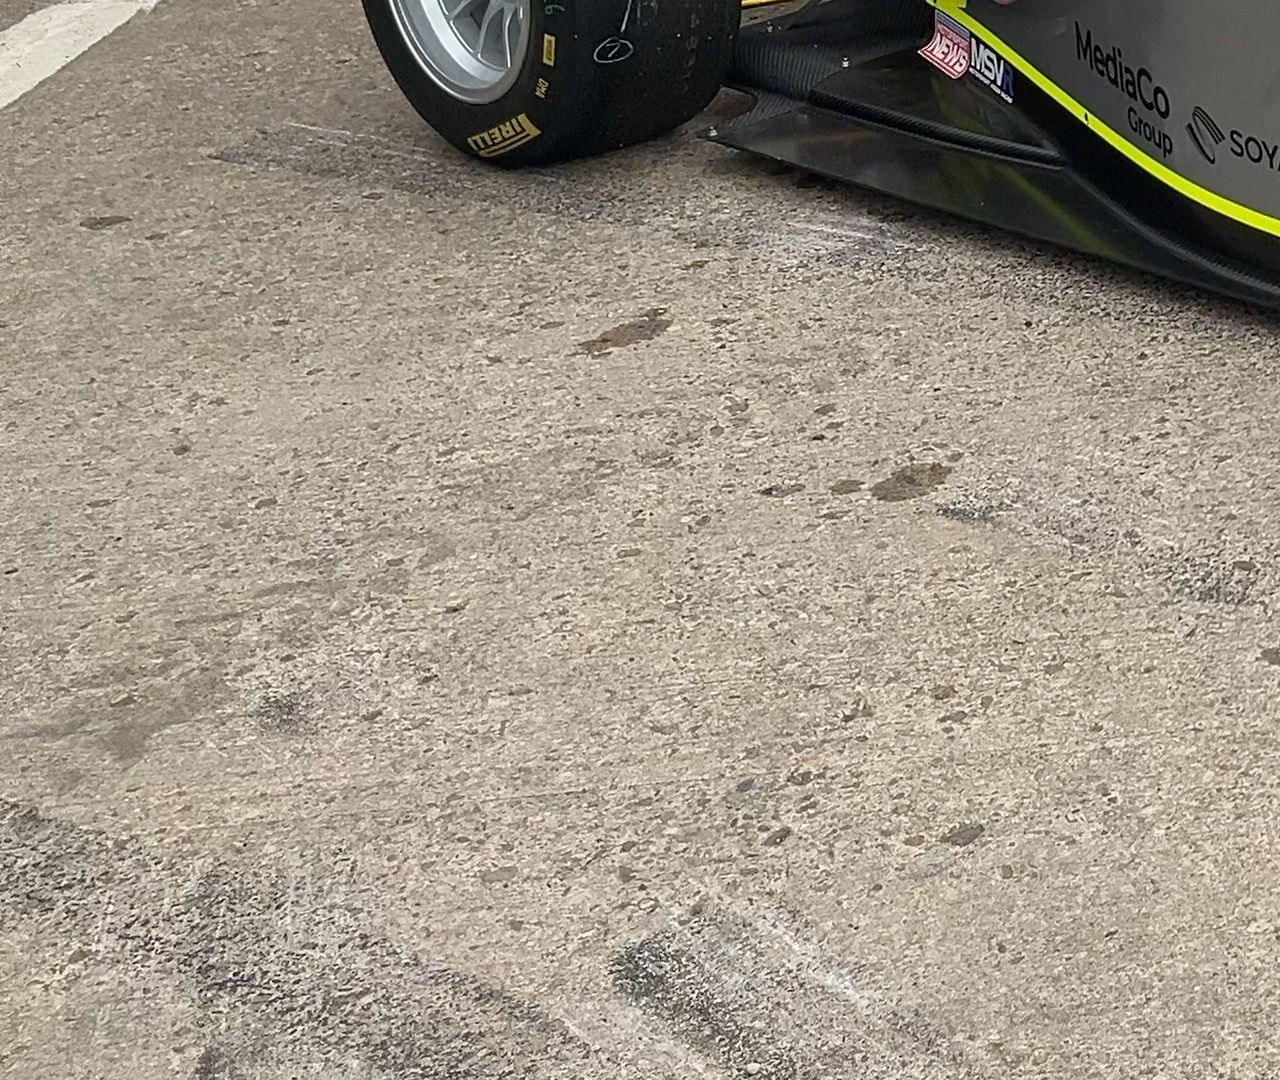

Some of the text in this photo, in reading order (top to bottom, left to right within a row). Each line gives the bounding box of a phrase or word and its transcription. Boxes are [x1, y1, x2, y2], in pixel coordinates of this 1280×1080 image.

[926, 32, 968, 73] NEWS
[1074, 20, 1170, 120] MediaCo
[467, 113, 543, 158] PIRELLI
[1127, 106, 1174, 158] Group
